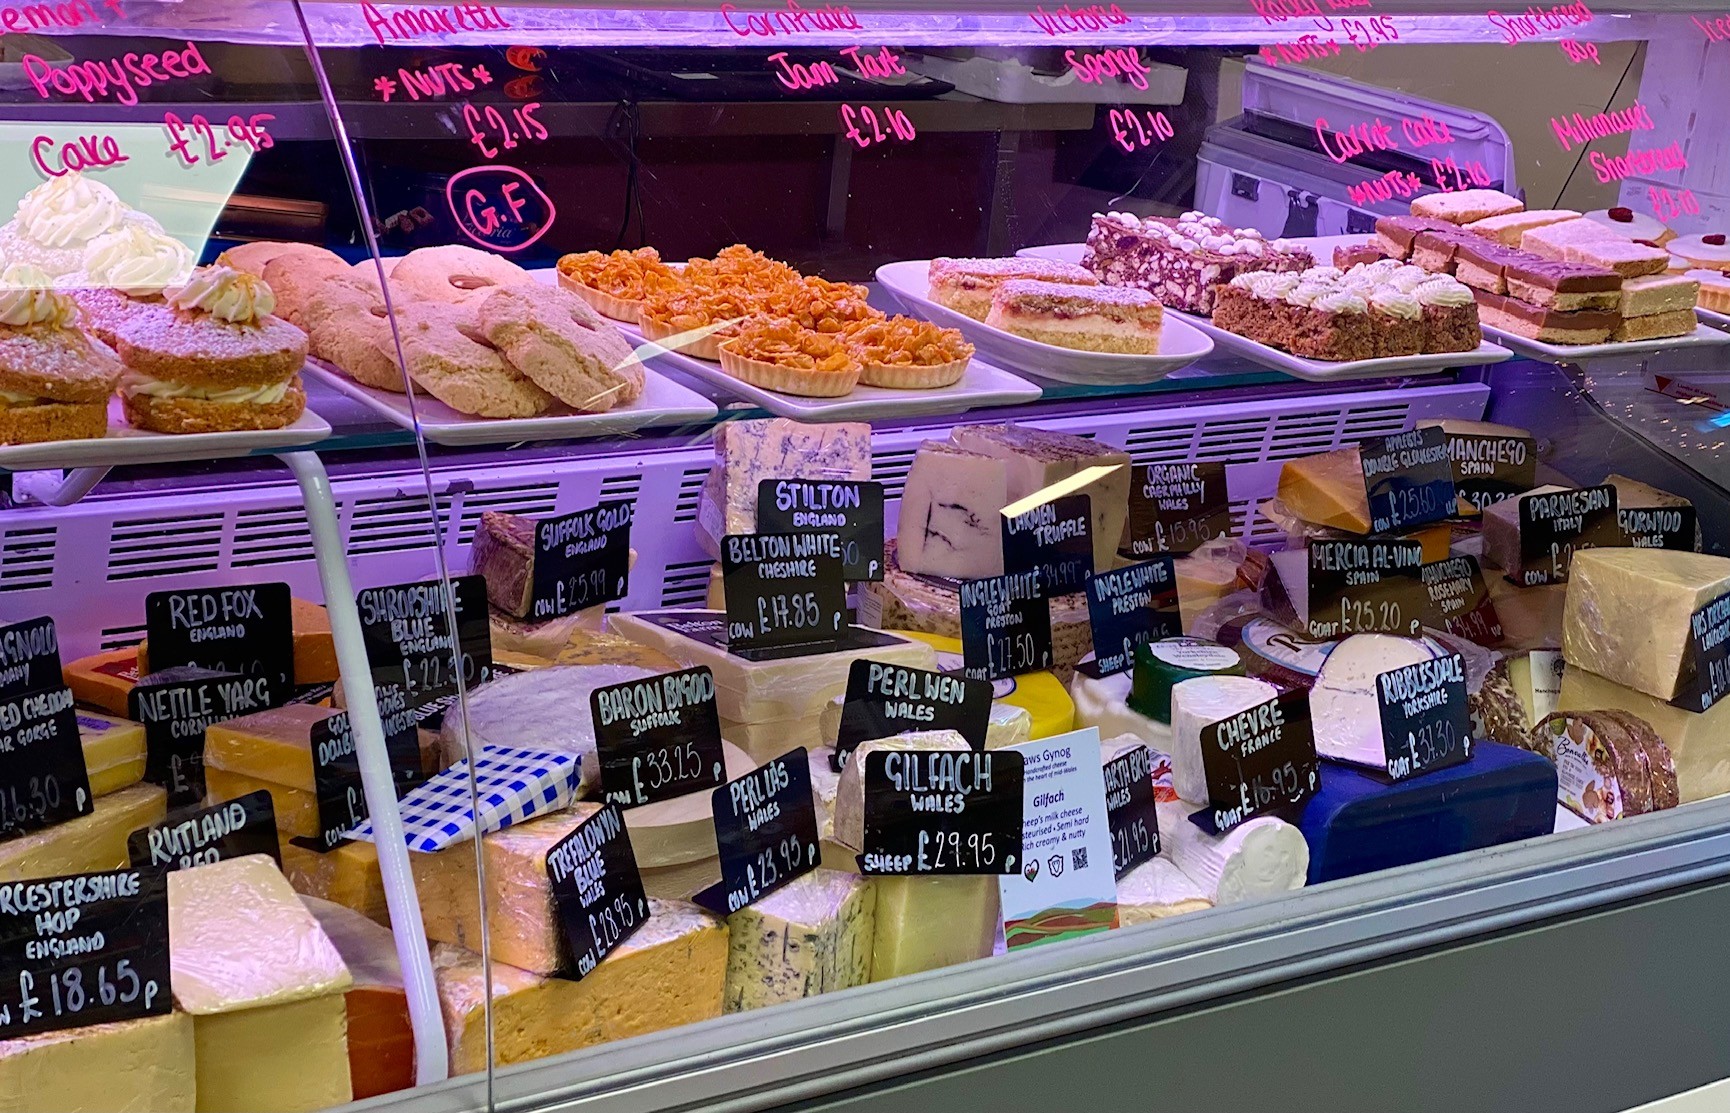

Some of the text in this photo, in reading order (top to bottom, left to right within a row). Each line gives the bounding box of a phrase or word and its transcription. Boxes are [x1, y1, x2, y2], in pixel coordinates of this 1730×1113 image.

[0, 2, 97, 35] emon
[360, 0, 512, 43] Amaretti
[1029, 3, 1131, 37] Victoria
[1341, 15, 1399, 51] £2.95
[1488, 0, 1595, 46] Shortbread
[1561, 38, 1601, 65] 80p
[22, 41, 212, 106] Poppyseed
[768, 45, 906, 89] Jam Tart
[1065, 47, 1150, 90] Sponge
[463, 102, 548, 158] £2.15
[841, 104, 916, 148] £2.10
[1110, 109, 1174, 152] £2.10
[1314, 117, 1398, 164] Carrot
[32, 112, 276, 177] Cake £2.95
[1431, 157, 1491, 193] £2.10
[1589, 140, 1688, 183] Shortbread
[1147, 465, 1200, 485] ORGANIC
[1460, 462, 1494, 475] SPAIN
[776, 481, 860, 511] STILTON
[1158, 499, 1188, 511] WALES
[1530, 488, 1610, 522] PARMESAN
[541, 503, 629, 551] SUFFOLK GOLD
[793, 512, 846, 527] ENGLAND
[1033, 516, 1087, 547] TRUFFLE
[1553, 515, 1583, 534] ITALY
[565, 534, 607, 557] ENGLAND
[728, 536, 790, 563] BELTON
[792, 534, 841, 558] WHITE
[1133, 538, 1153, 554] COW
[1632, 534, 1664, 549] WALES
[758, 559, 817, 579] CHESHIRE
[1312, 543, 1370, 571] MERCIA
[961, 572, 1041, 608] INGLEWHITE
[1094, 562, 1167, 602] INGLEWHITE
[1346, 570, 1380, 585] SPAIN
[1427, 578, 1475, 602] ROSEMARY
[1525, 570, 1547, 586] COW
[169, 589, 263, 629] RED FOX
[534, 598, 555, 617] COW
[729, 592, 821, 639] COW £17.85
[1113, 590, 1152, 615] PRESTON
[1309, 596, 1401, 638] GOAT £25.20
[190, 624, 245, 643] ENGLAND
[391, 617, 434, 642] BLUE
[986, 612, 1023, 629] PRESTON
[1098, 652, 1124, 674] SHEEP
[868, 664, 966, 705] PERL WEN
[1381, 654, 1464, 705] RIBBLESDALE
[138, 684, 212, 723] NETTLE
[218, 677, 270, 707] YARG
[599, 672, 715, 725] BARON BIGOD
[885, 702, 935, 721] WALES
[1402, 690, 1448, 719] YORKSHIRE
[17, 719, 58, 747] GORGE
[1217, 700, 1285, 751] CHEVRE
[1043, 747, 1071, 761] Gynog
[1241, 726, 1282, 757] FRANCE
[632, 742, 701, 804] £33.25
[885, 753, 992, 794] GILFACH
[1035, 772, 1047, 780] heart
[1131, 748, 1151, 783] BRIE
[730, 775, 766, 816] PERL
[911, 793, 965, 814] WALES
[1033, 790, 1064, 808] Gilfach
[1107, 787, 1131, 811] WALES
[748, 802, 781, 832] WALES
[1045, 811, 1058, 822] milk
[1060, 807, 1083, 819] cheese
[1056, 820, 1073, 832] Semi
[1074, 815, 1090, 825] hard
[1214, 807, 1241, 831] GOAT
[149, 802, 246, 866] RUTLAND
[1035, 834, 1060, 848] creamy
[1061, 832, 1067, 841] &
[1068, 829, 1086, 840] nutty
[864, 830, 995, 872] SHEEP £29.95
[574, 850, 606, 894] BLUE
[729, 835, 801, 912] COW £23.95
[580, 880, 606, 908] WALES
[35, 907, 81, 936] HOP
[26, 931, 105, 960] ENGLAND
[578, 950, 596, 976] COW
[20, 959, 141, 1024] £18.65
